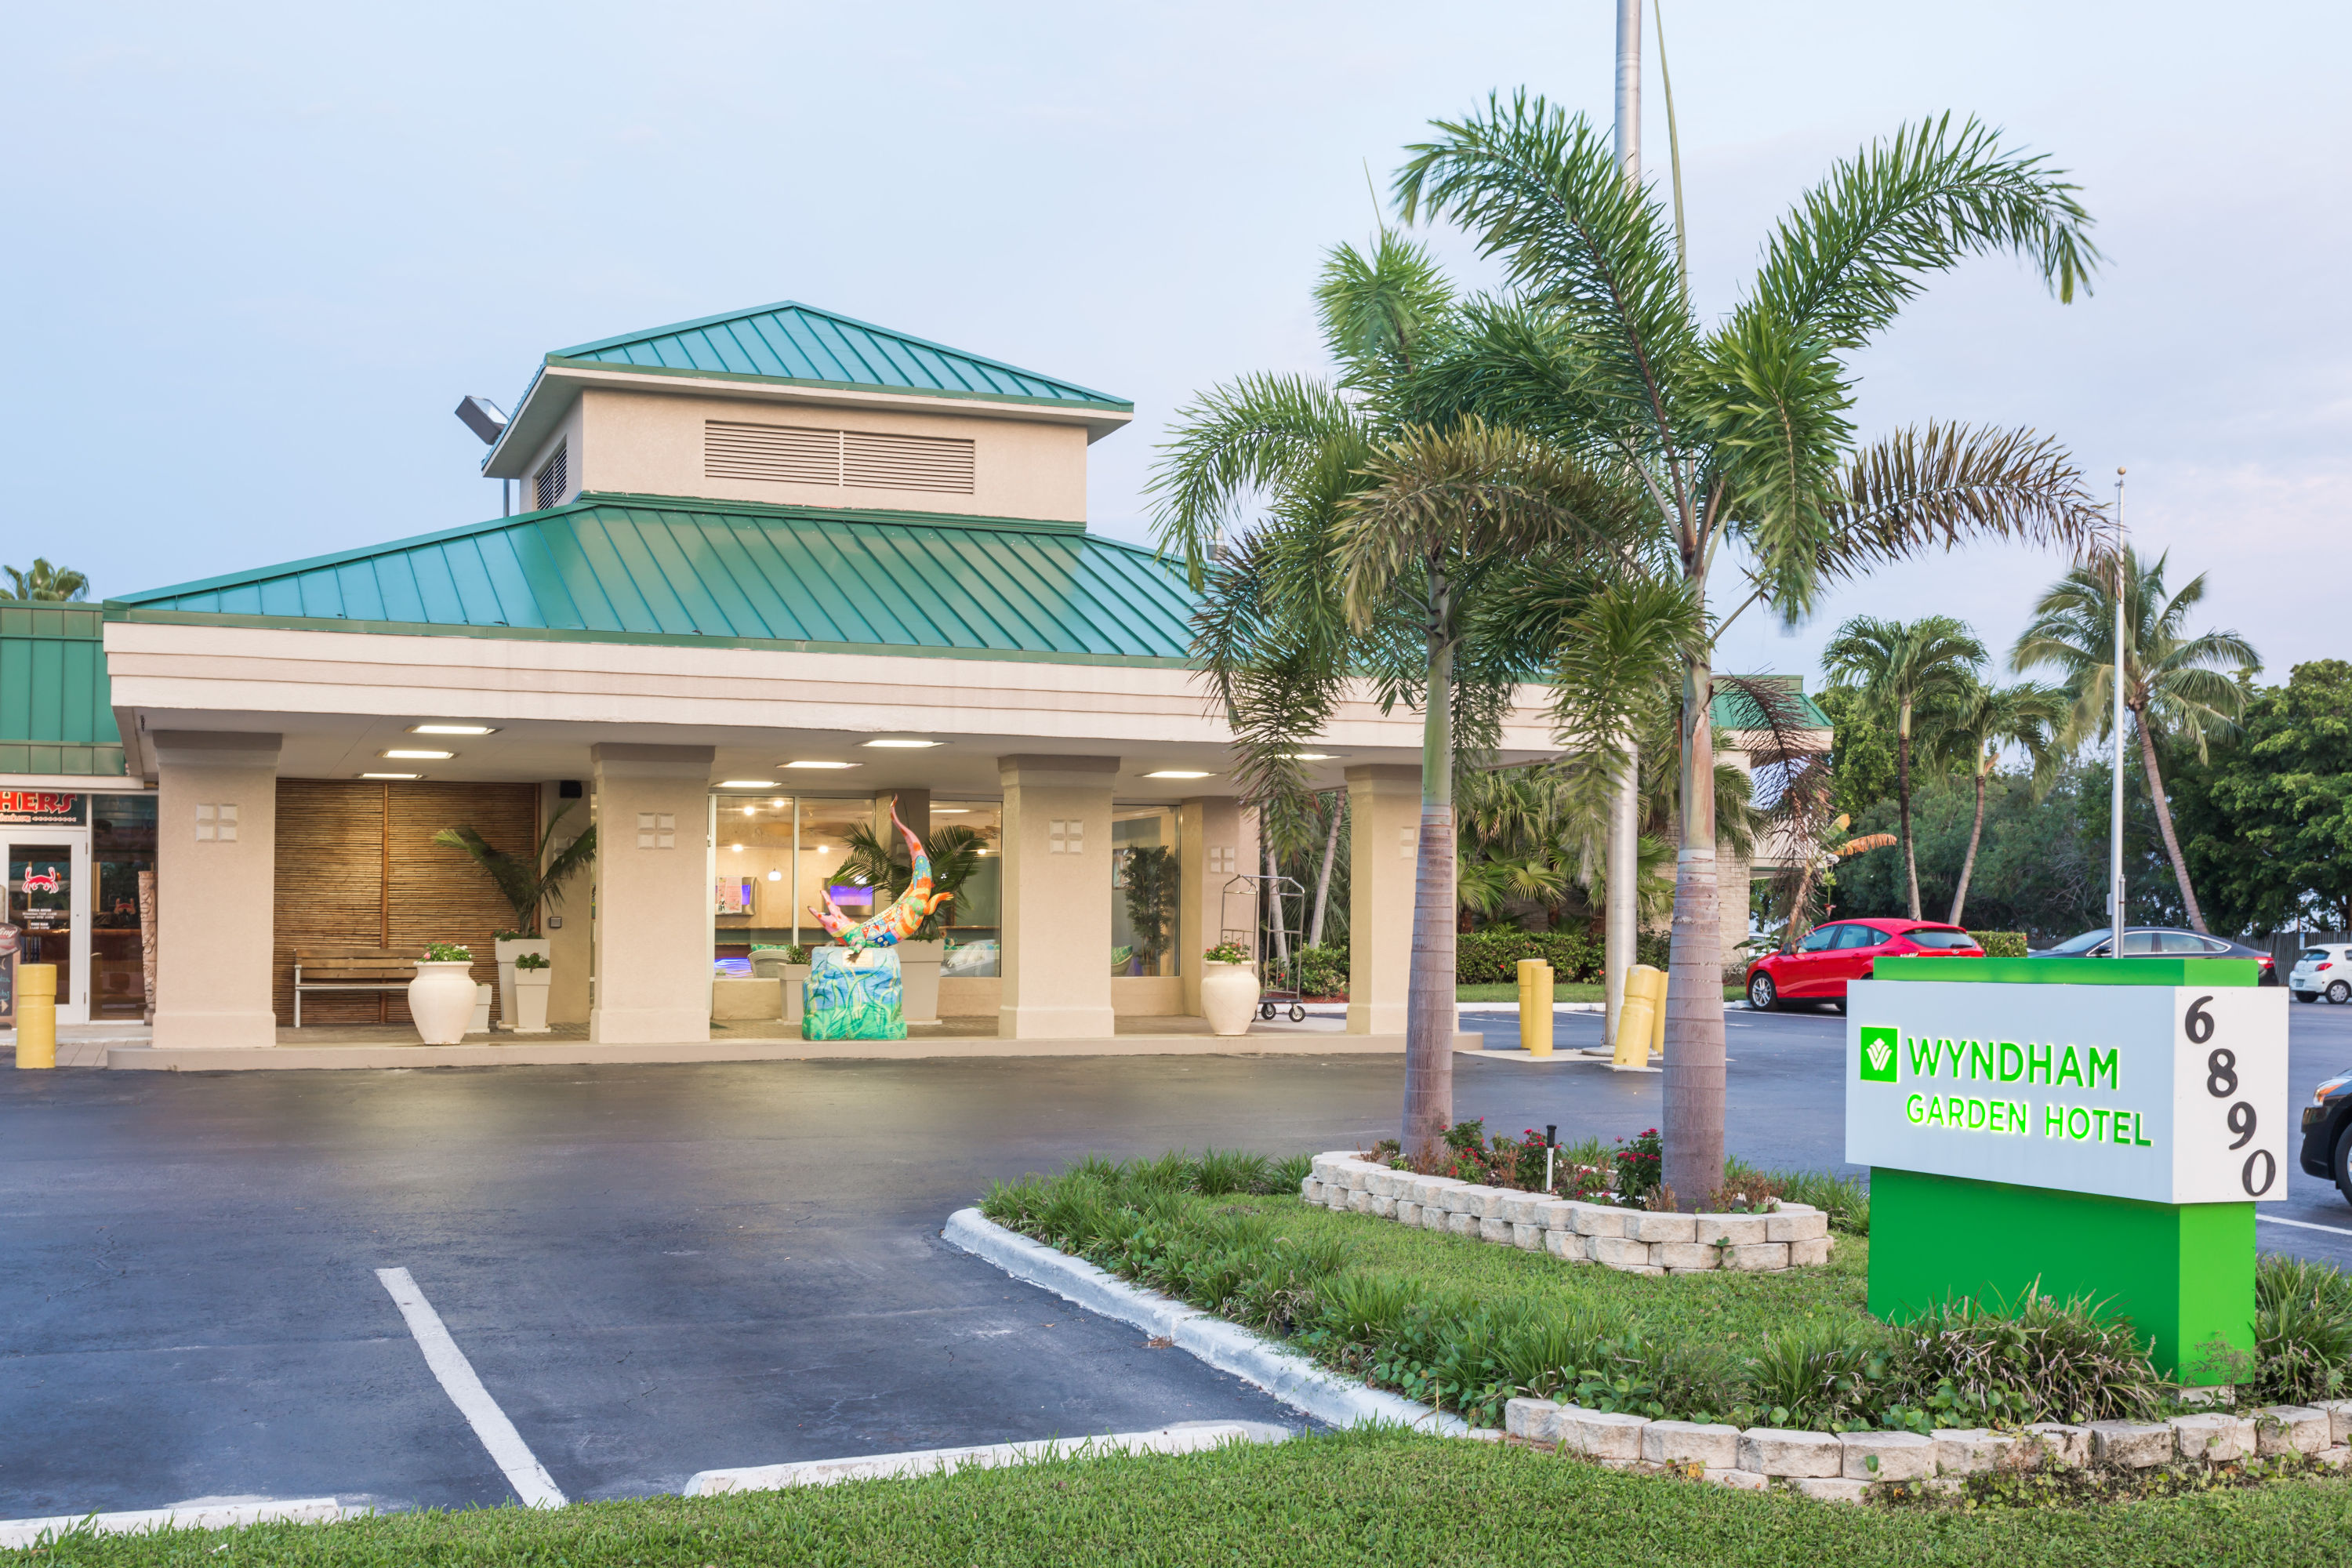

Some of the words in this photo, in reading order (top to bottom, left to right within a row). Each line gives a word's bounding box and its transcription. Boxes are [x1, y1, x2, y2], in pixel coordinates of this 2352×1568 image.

[1907, 1036, 2120, 1091] WYNDHAM
[1906, 1093, 2029, 1135] GARDEN
[2045, 1105, 2154, 1147] HOTEL
